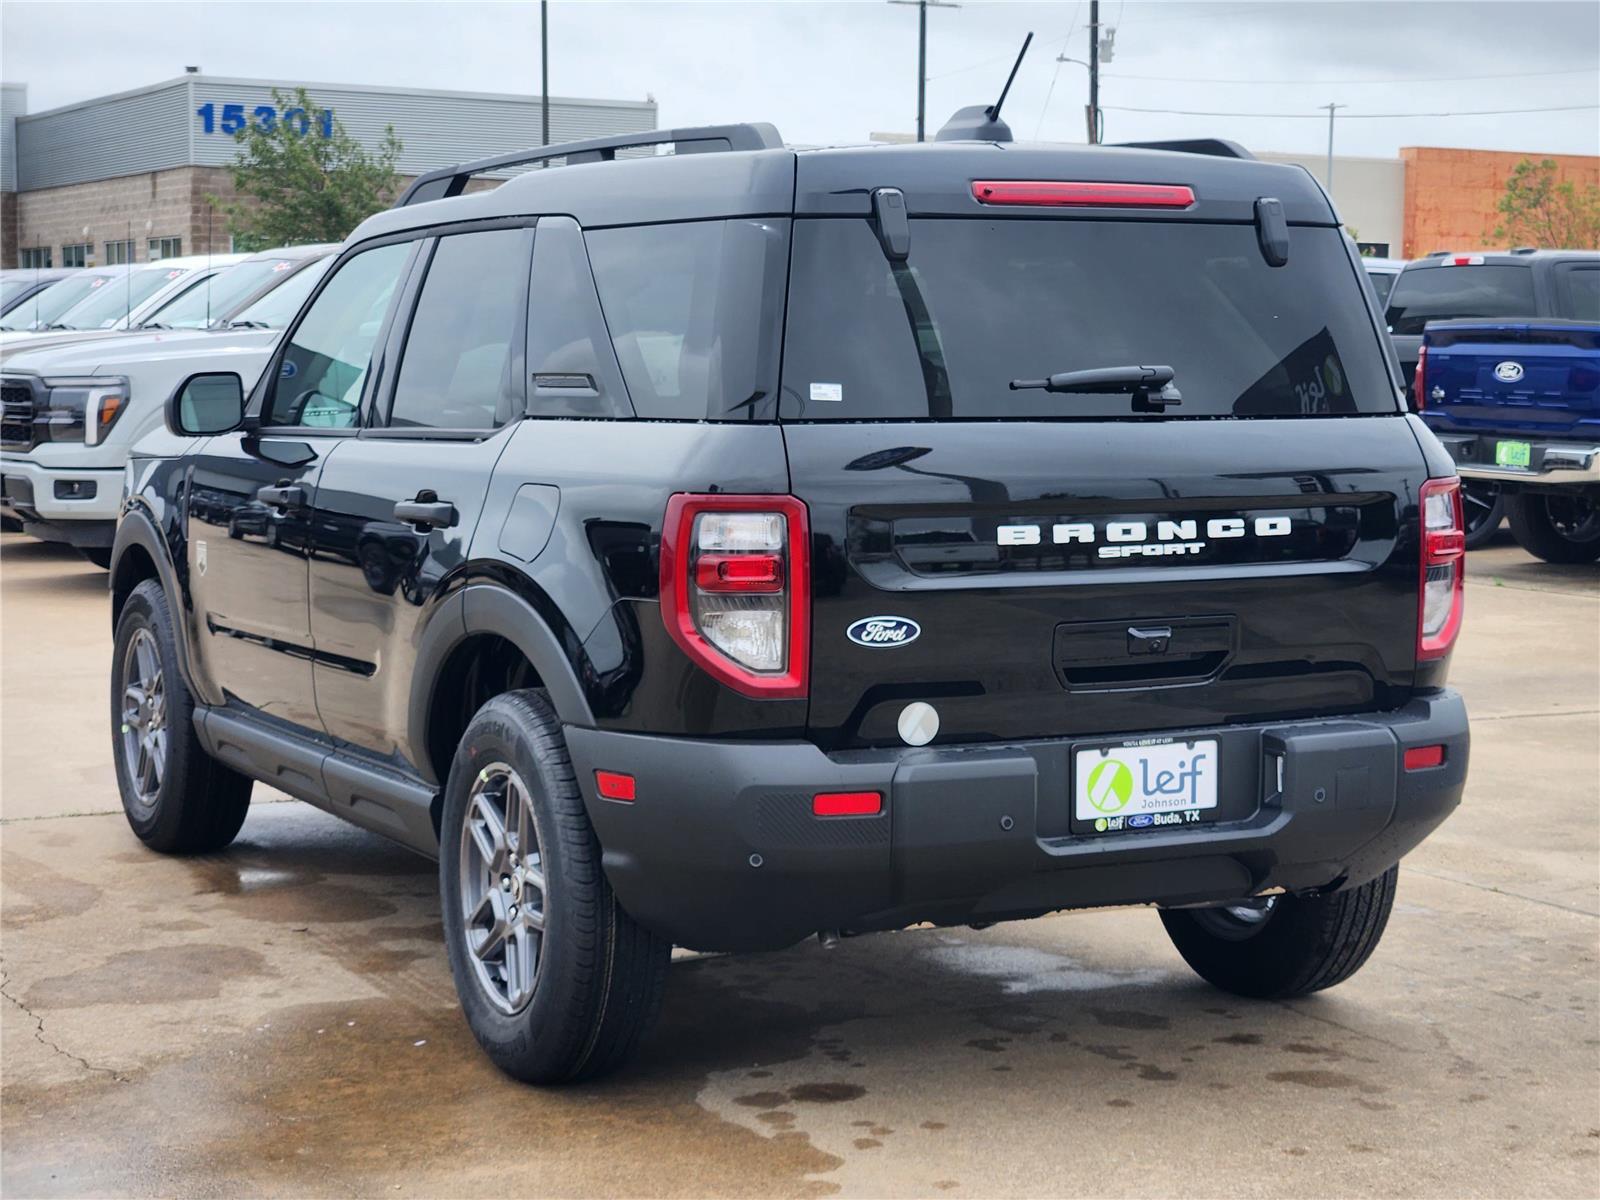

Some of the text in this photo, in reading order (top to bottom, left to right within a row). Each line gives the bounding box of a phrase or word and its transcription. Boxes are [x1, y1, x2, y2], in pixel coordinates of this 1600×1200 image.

[197, 103, 333, 139] 15301
[997, 516, 1292, 546] BRONCO
[1098, 542, 1206, 559] SPORT
[861, 620, 908, 642] Ford
[1139, 754, 1206, 804] leif
[1141, 798, 1187, 809] Johnson
[1107, 816, 1124, 830] leif
[1154, 813, 1182, 825] Buda,
[1184, 810, 1200, 822] TX
